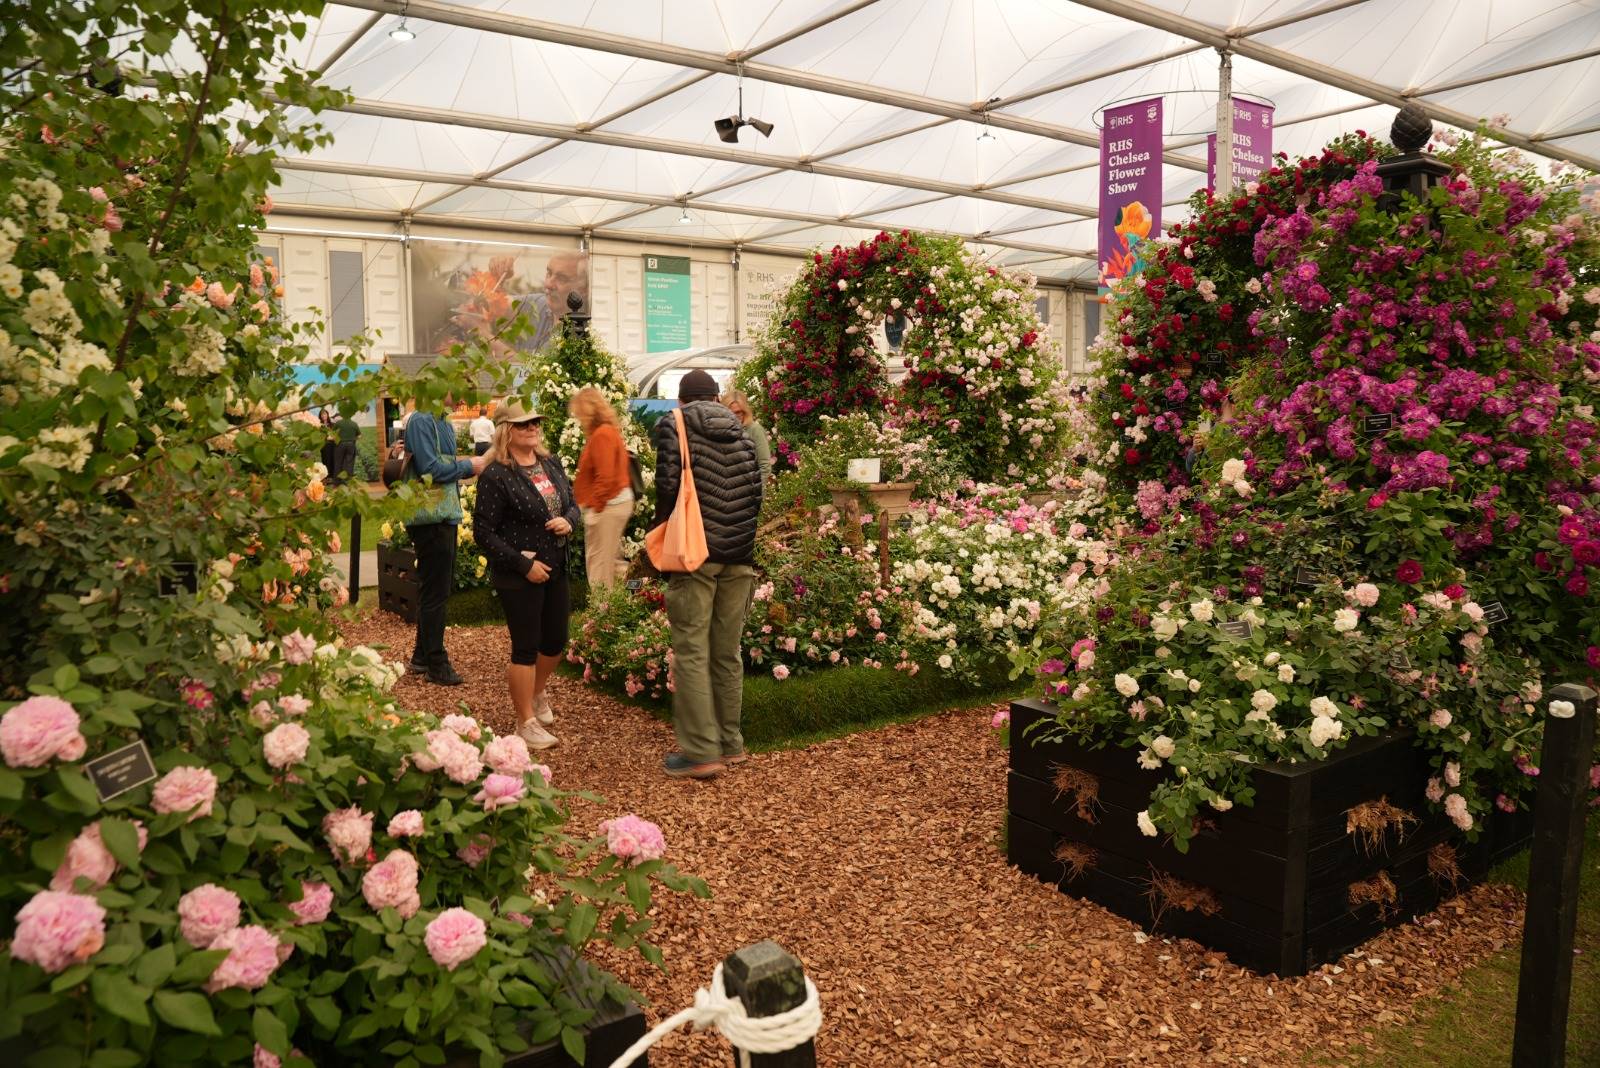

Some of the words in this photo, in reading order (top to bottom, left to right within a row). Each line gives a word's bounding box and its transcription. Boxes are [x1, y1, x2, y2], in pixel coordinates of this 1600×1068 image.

[1117, 114, 1133, 126] RHS
[1239, 109, 1252, 121] RHS
[1109, 138, 1132, 154] RHS
[1233, 133, 1252, 147] RHS
[1109, 151, 1150, 167] Chelsea
[1233, 148, 1264, 165] Chelsea
[1109, 166, 1146, 181] Flower
[1233, 162, 1261, 177] Flower
[1108, 182, 1138, 195] Show
[756, 272, 774, 282] RHS
